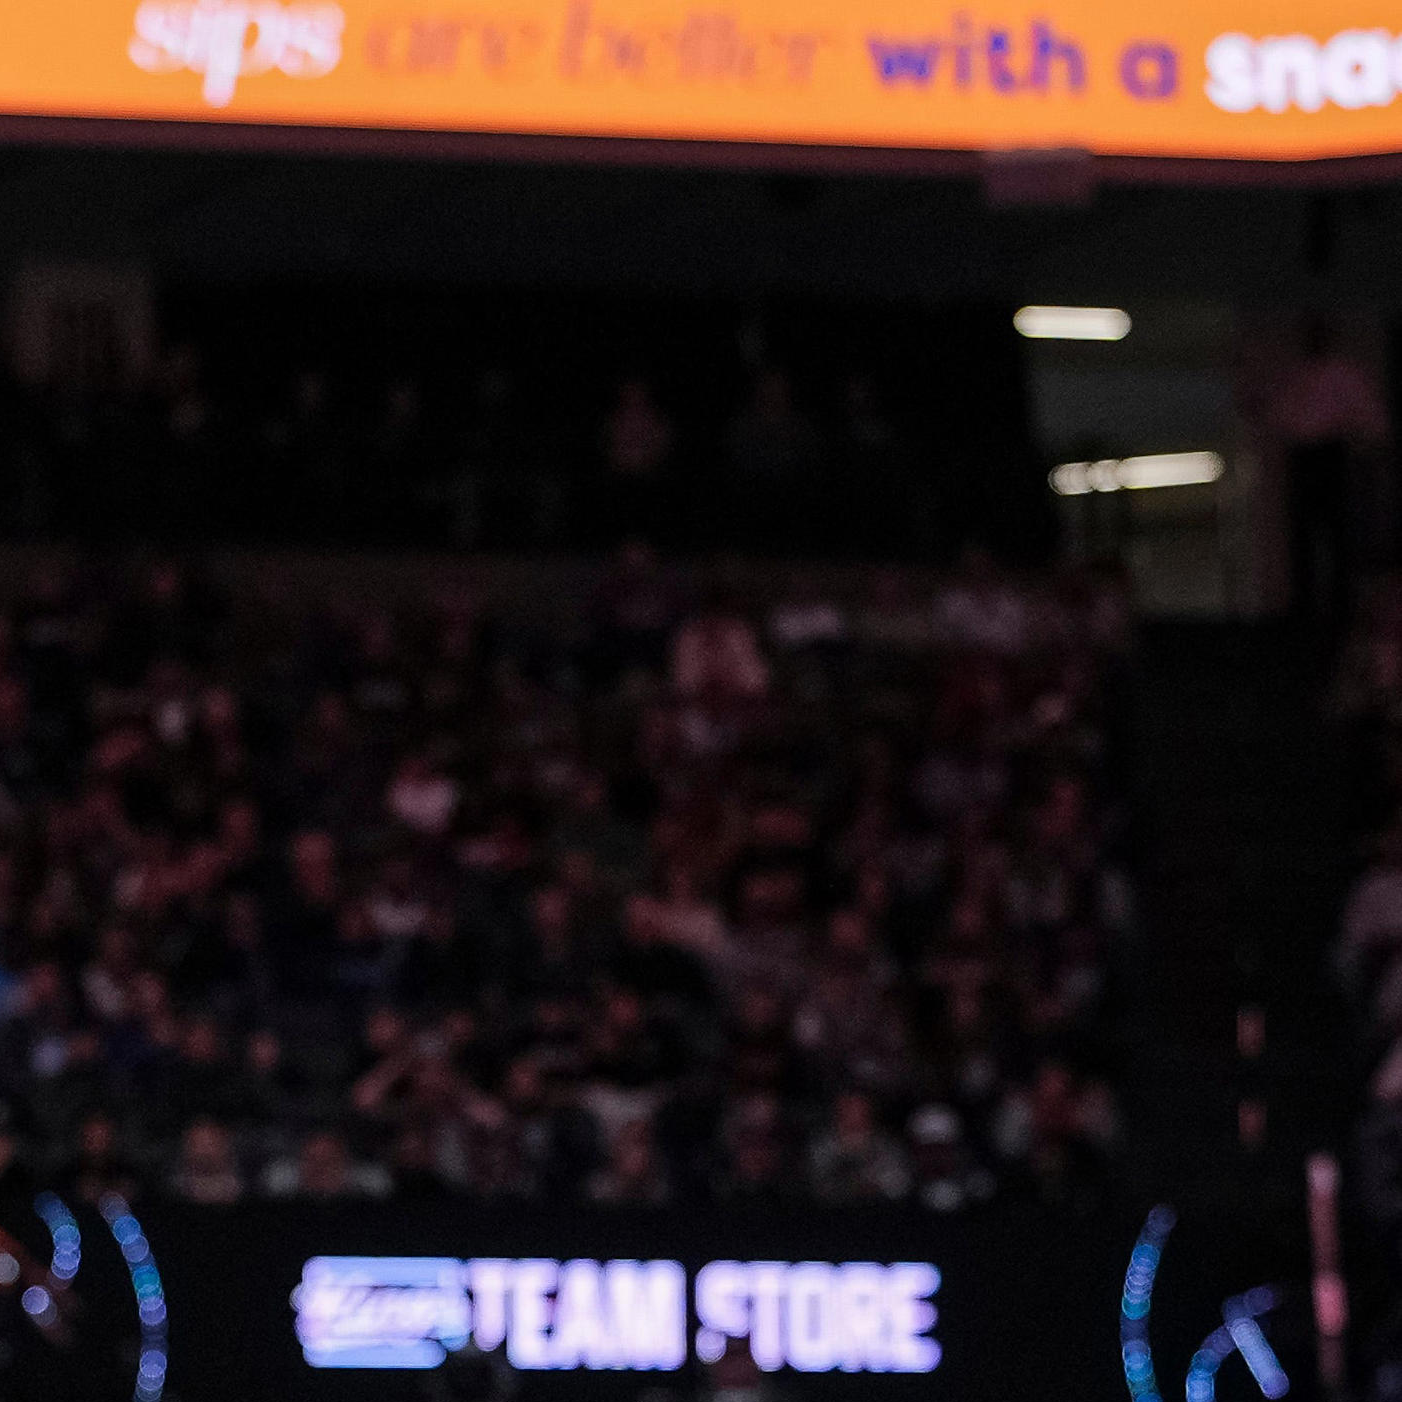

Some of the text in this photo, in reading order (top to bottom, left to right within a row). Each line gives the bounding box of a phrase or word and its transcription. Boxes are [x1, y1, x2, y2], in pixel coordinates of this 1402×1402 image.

[865, 14, 1089, 98] with
[1117, 39, 1183, 104] a
[1205, 28, 1402, 114] sna
[466, 1258, 687, 1371] TEAM
[695, 1260, 941, 1373] STORE
